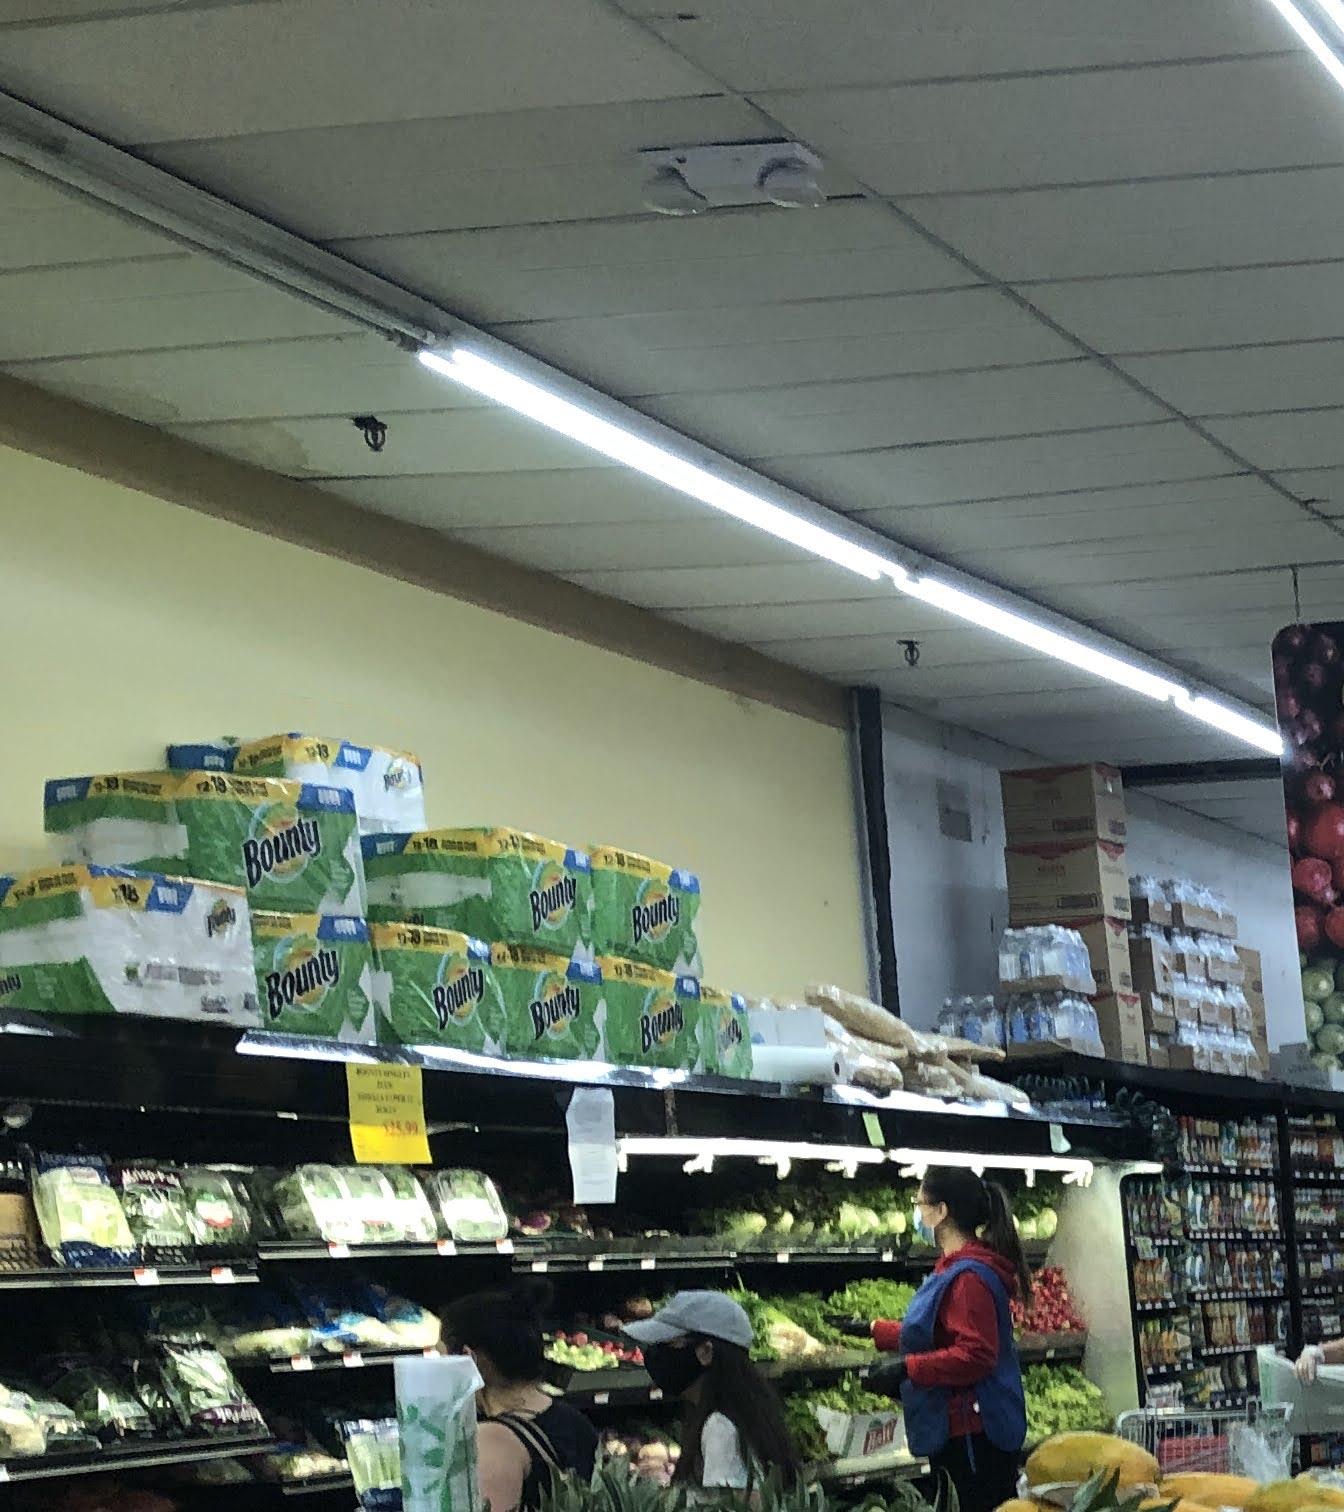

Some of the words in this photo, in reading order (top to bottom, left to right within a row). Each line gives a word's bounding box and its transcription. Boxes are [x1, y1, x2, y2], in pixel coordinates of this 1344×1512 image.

[242, 818, 321, 889] Bounty
[529, 876, 577, 933] Bounty
[632, 893, 680, 945] Bounty
[264, 948, 340, 1021] Bounty
[432, 967, 485, 1031] Bounty
[529, 985, 581, 1041] Bounty
